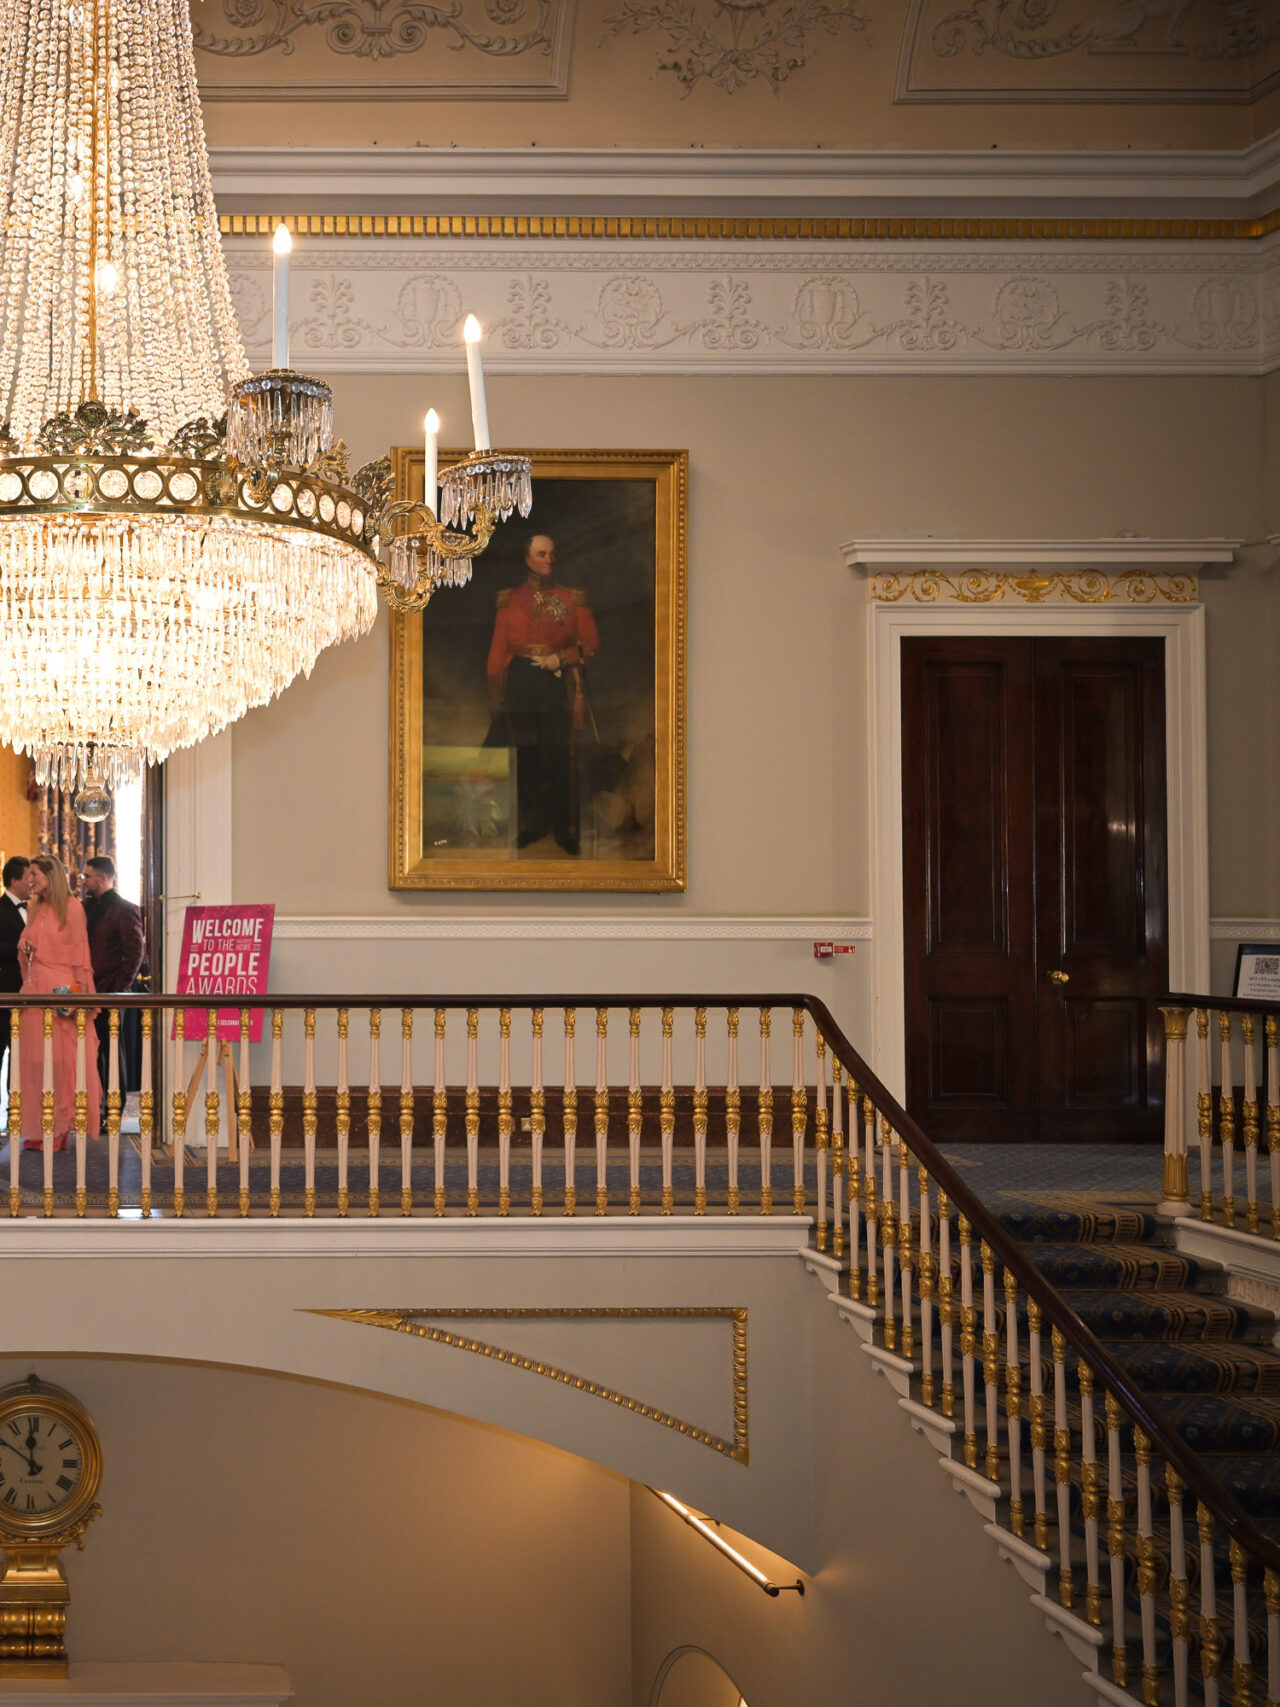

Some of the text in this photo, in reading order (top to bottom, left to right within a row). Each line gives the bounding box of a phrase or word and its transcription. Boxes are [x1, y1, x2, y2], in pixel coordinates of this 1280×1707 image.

[192, 918, 264, 943] WELCOME
[203, 939, 215, 951] TO
[218, 939, 235, 951] THE
[187, 952, 260, 976] PEOPLE
[186, 976, 257, 994] AWARDS
[58, 1438, 73, 1450] II
[63, 1459, 78, 1468] III
